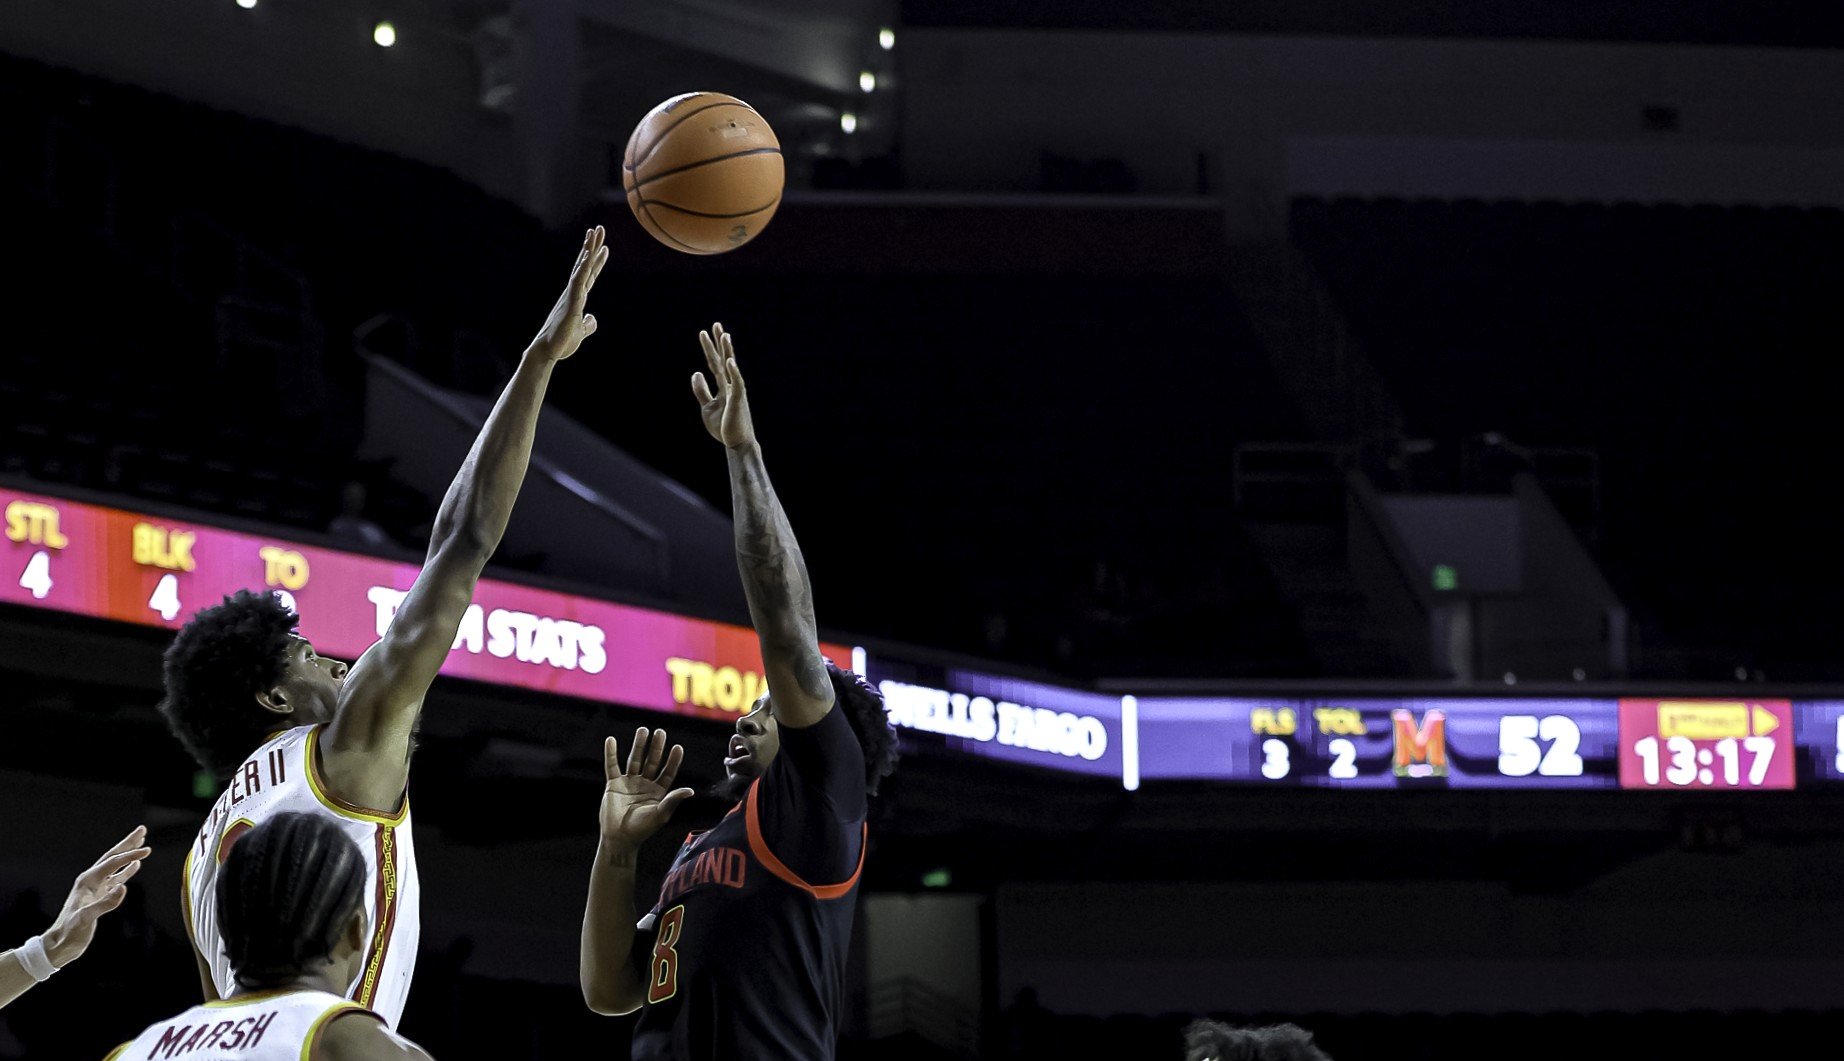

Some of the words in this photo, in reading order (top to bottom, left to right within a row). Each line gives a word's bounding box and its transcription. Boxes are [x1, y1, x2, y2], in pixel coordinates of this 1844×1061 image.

[5, 501, 69, 550] STL
[132, 523, 196, 572] BLK
[260, 546, 310, 591] TO
[19, 551, 53, 599] 4
[149, 574, 181, 621] 4
[367, 586, 485, 654] TM
[487, 608, 608, 675] STATS
[665, 657, 769, 716] TROJ
[1261, 739, 1291, 780] 3
[1328, 739, 1359, 779] 2
[1499, 715, 1583, 777] 52
[1634, 736, 1776, 786] 13:17
[648, 904, 685, 1004] 8
[146, 1011, 279, 1061] MARSH
